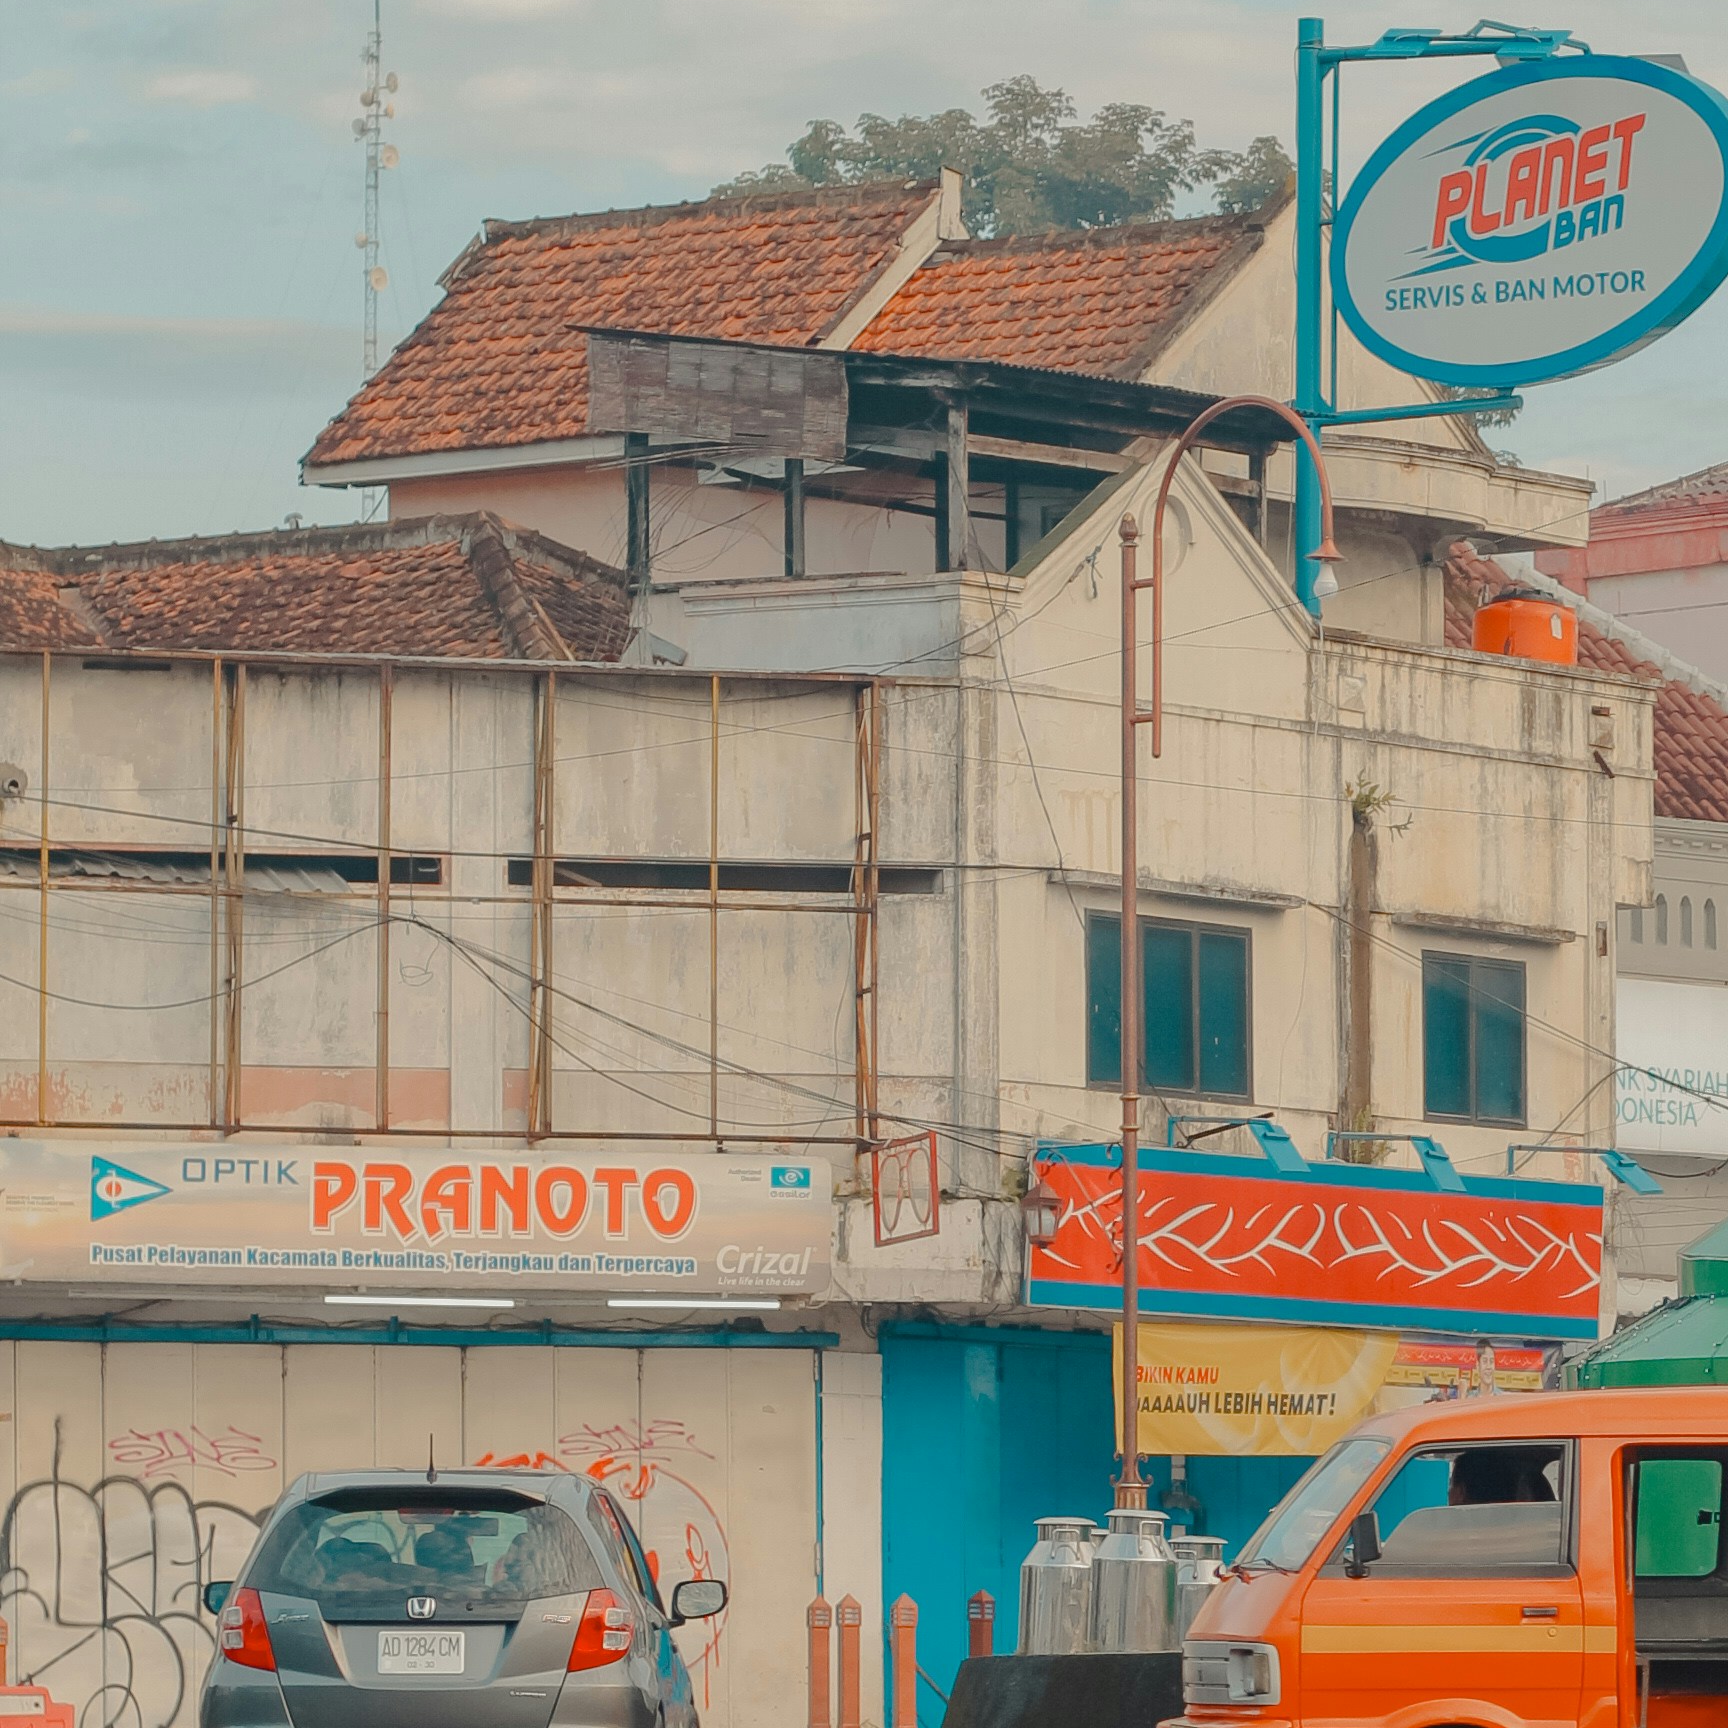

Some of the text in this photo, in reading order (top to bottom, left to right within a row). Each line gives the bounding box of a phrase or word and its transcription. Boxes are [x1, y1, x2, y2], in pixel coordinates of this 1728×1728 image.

[1431, 113, 1646, 249] PLANET
[1553, 194, 1624, 251] BAN
[1385, 270, 1646, 312] SERVIS & BAN MOTOR
[182, 1158, 696, 1245] OPTIK PRANOTO
[90, 1244, 695, 1277] Pusat Pelayanan Kacamata Berkualitas, Terjangkau dan Terpercaya
[716, 1244, 813, 1275] Crizal
[1137, 1365, 1219, 1385] BIKIN KAMU
[1215, 1391, 1262, 1416] LEBIH
[1266, 1392, 1336, 1417] HEMAT!
[382, 1635, 461, 1658] AD 1284 CM
